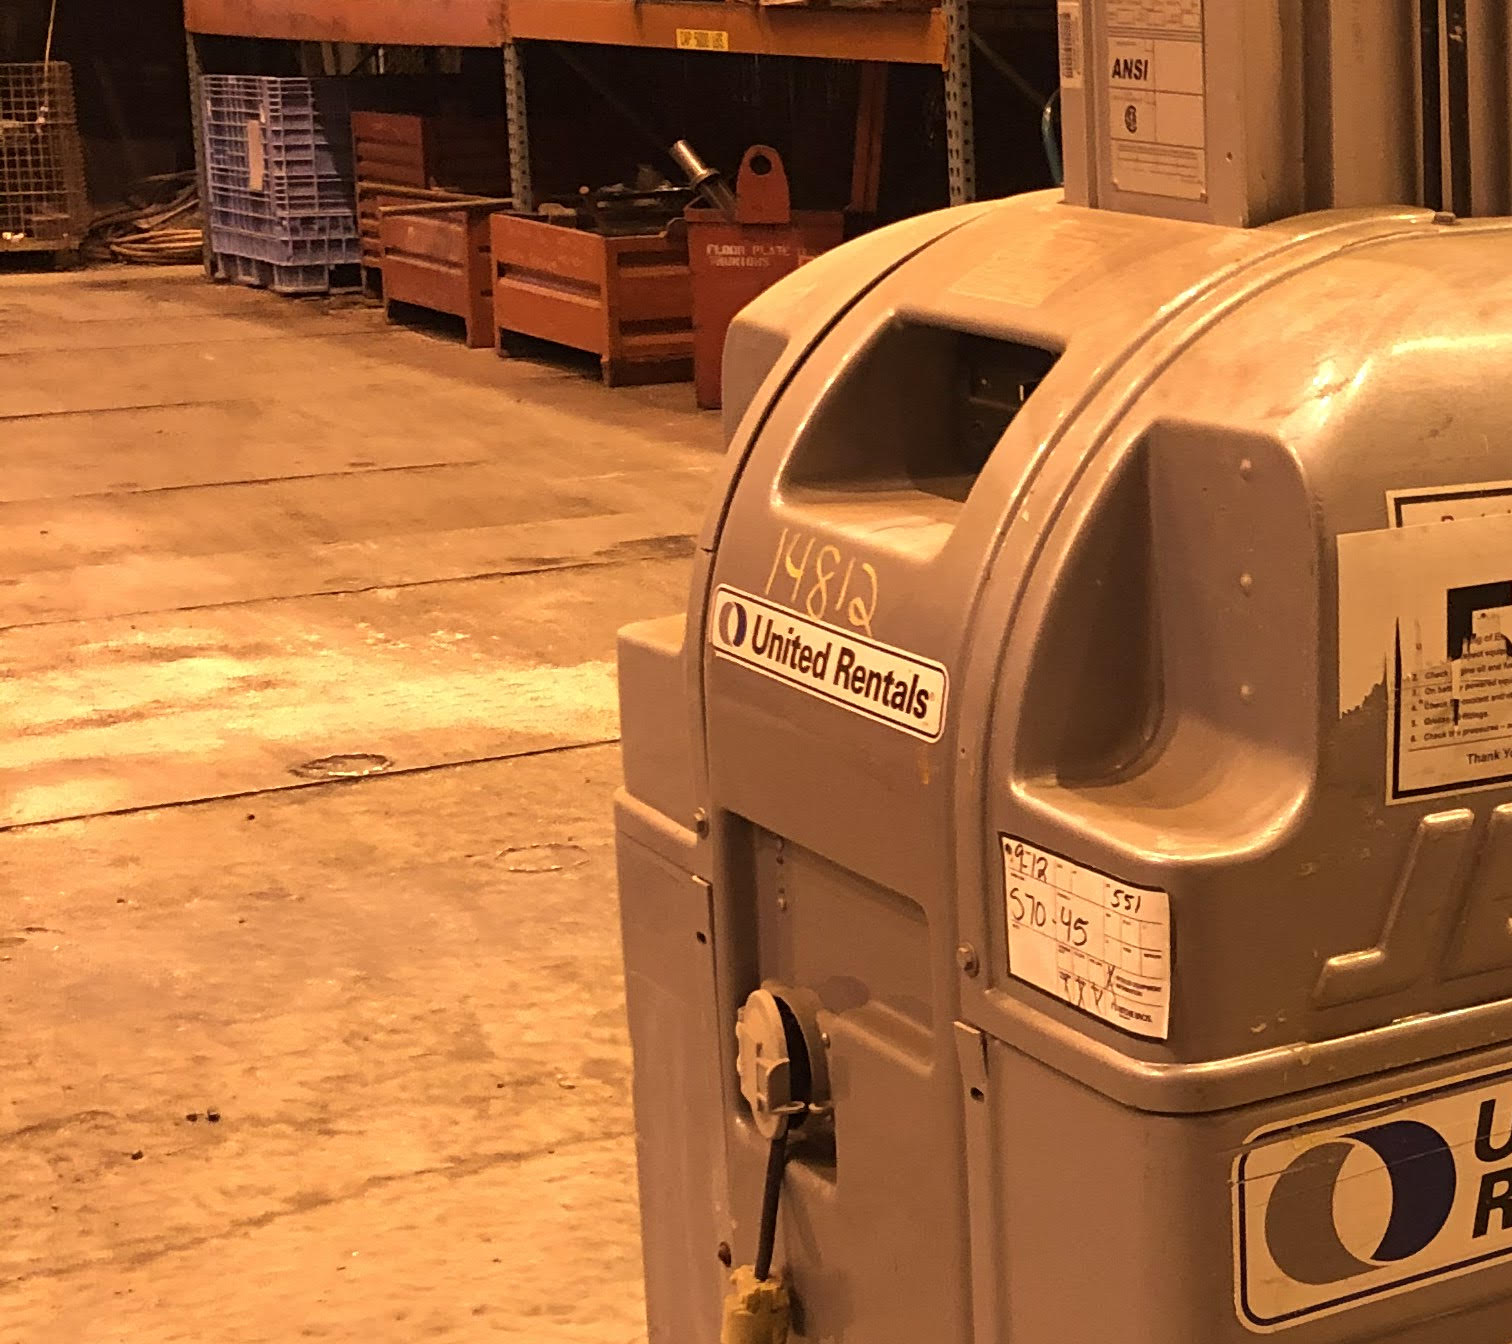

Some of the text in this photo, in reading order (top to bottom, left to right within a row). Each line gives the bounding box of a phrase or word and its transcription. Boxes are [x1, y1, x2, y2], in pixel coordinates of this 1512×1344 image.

[1111, 57, 1149, 81] ANSI
[706, 244, 745, 256] FLOOR
[751, 614, 930, 719] United Rentals
[1467, 749, 1500, 765] Thank
